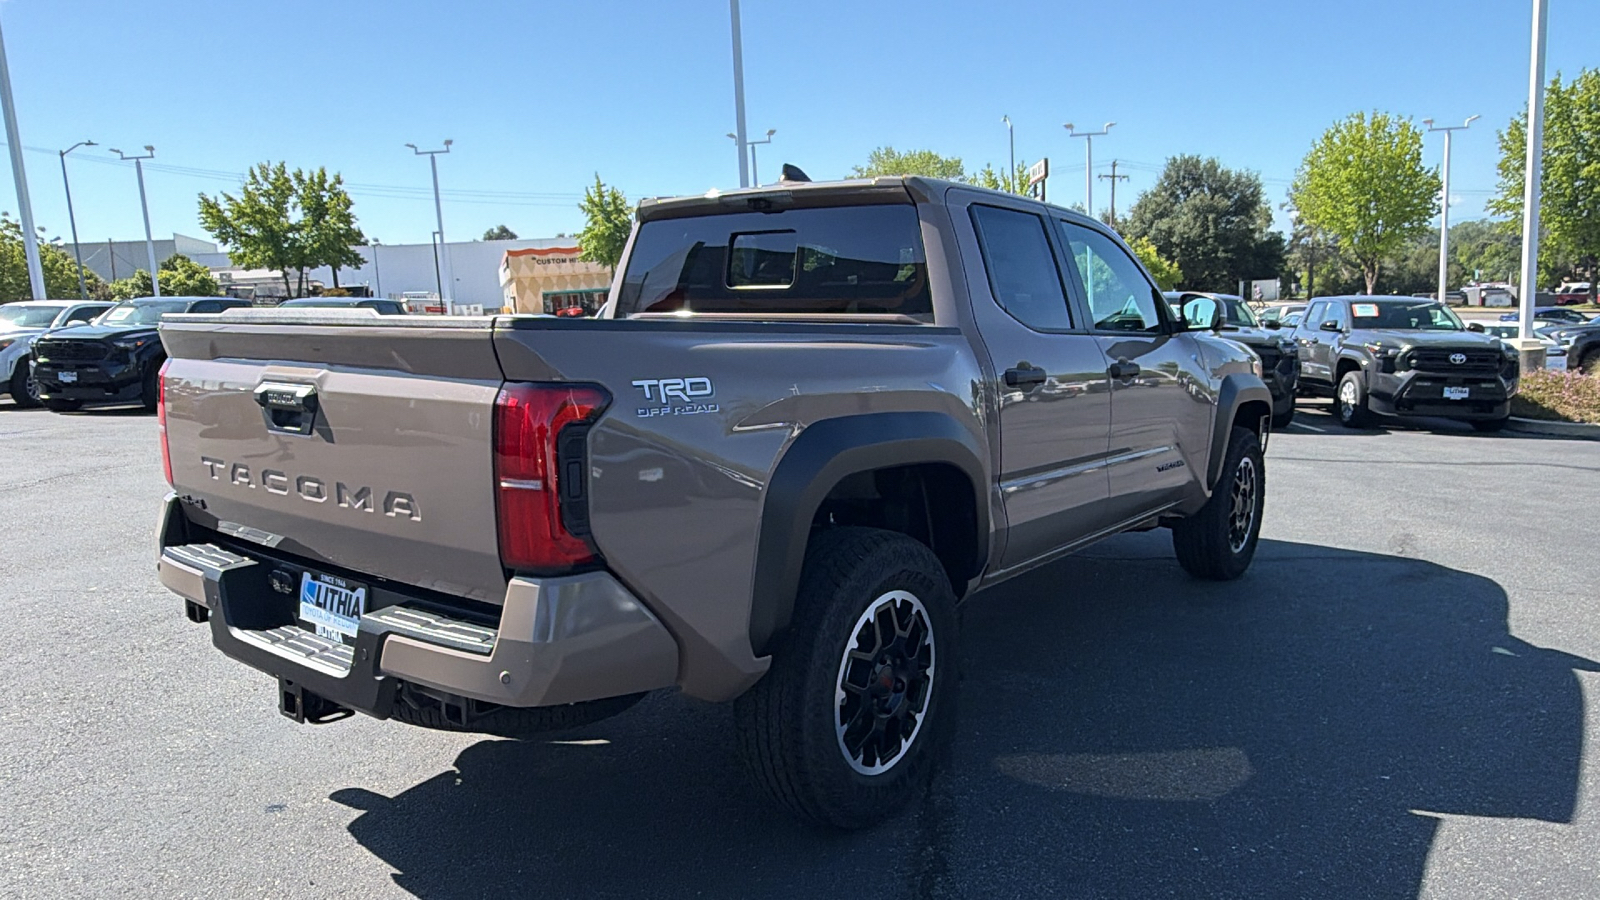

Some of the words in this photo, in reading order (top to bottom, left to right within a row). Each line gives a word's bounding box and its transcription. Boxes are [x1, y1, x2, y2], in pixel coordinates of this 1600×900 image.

[631, 377, 713, 404] TRD
[637, 406, 671, 418] OFF
[673, 403, 720, 416] ROAD
[201, 456, 422, 522] TACOMA
[320, 574, 335, 585] SINCE
[303, 604, 324, 620] TOYOTA
[315, 584, 362, 621] LITHIA
